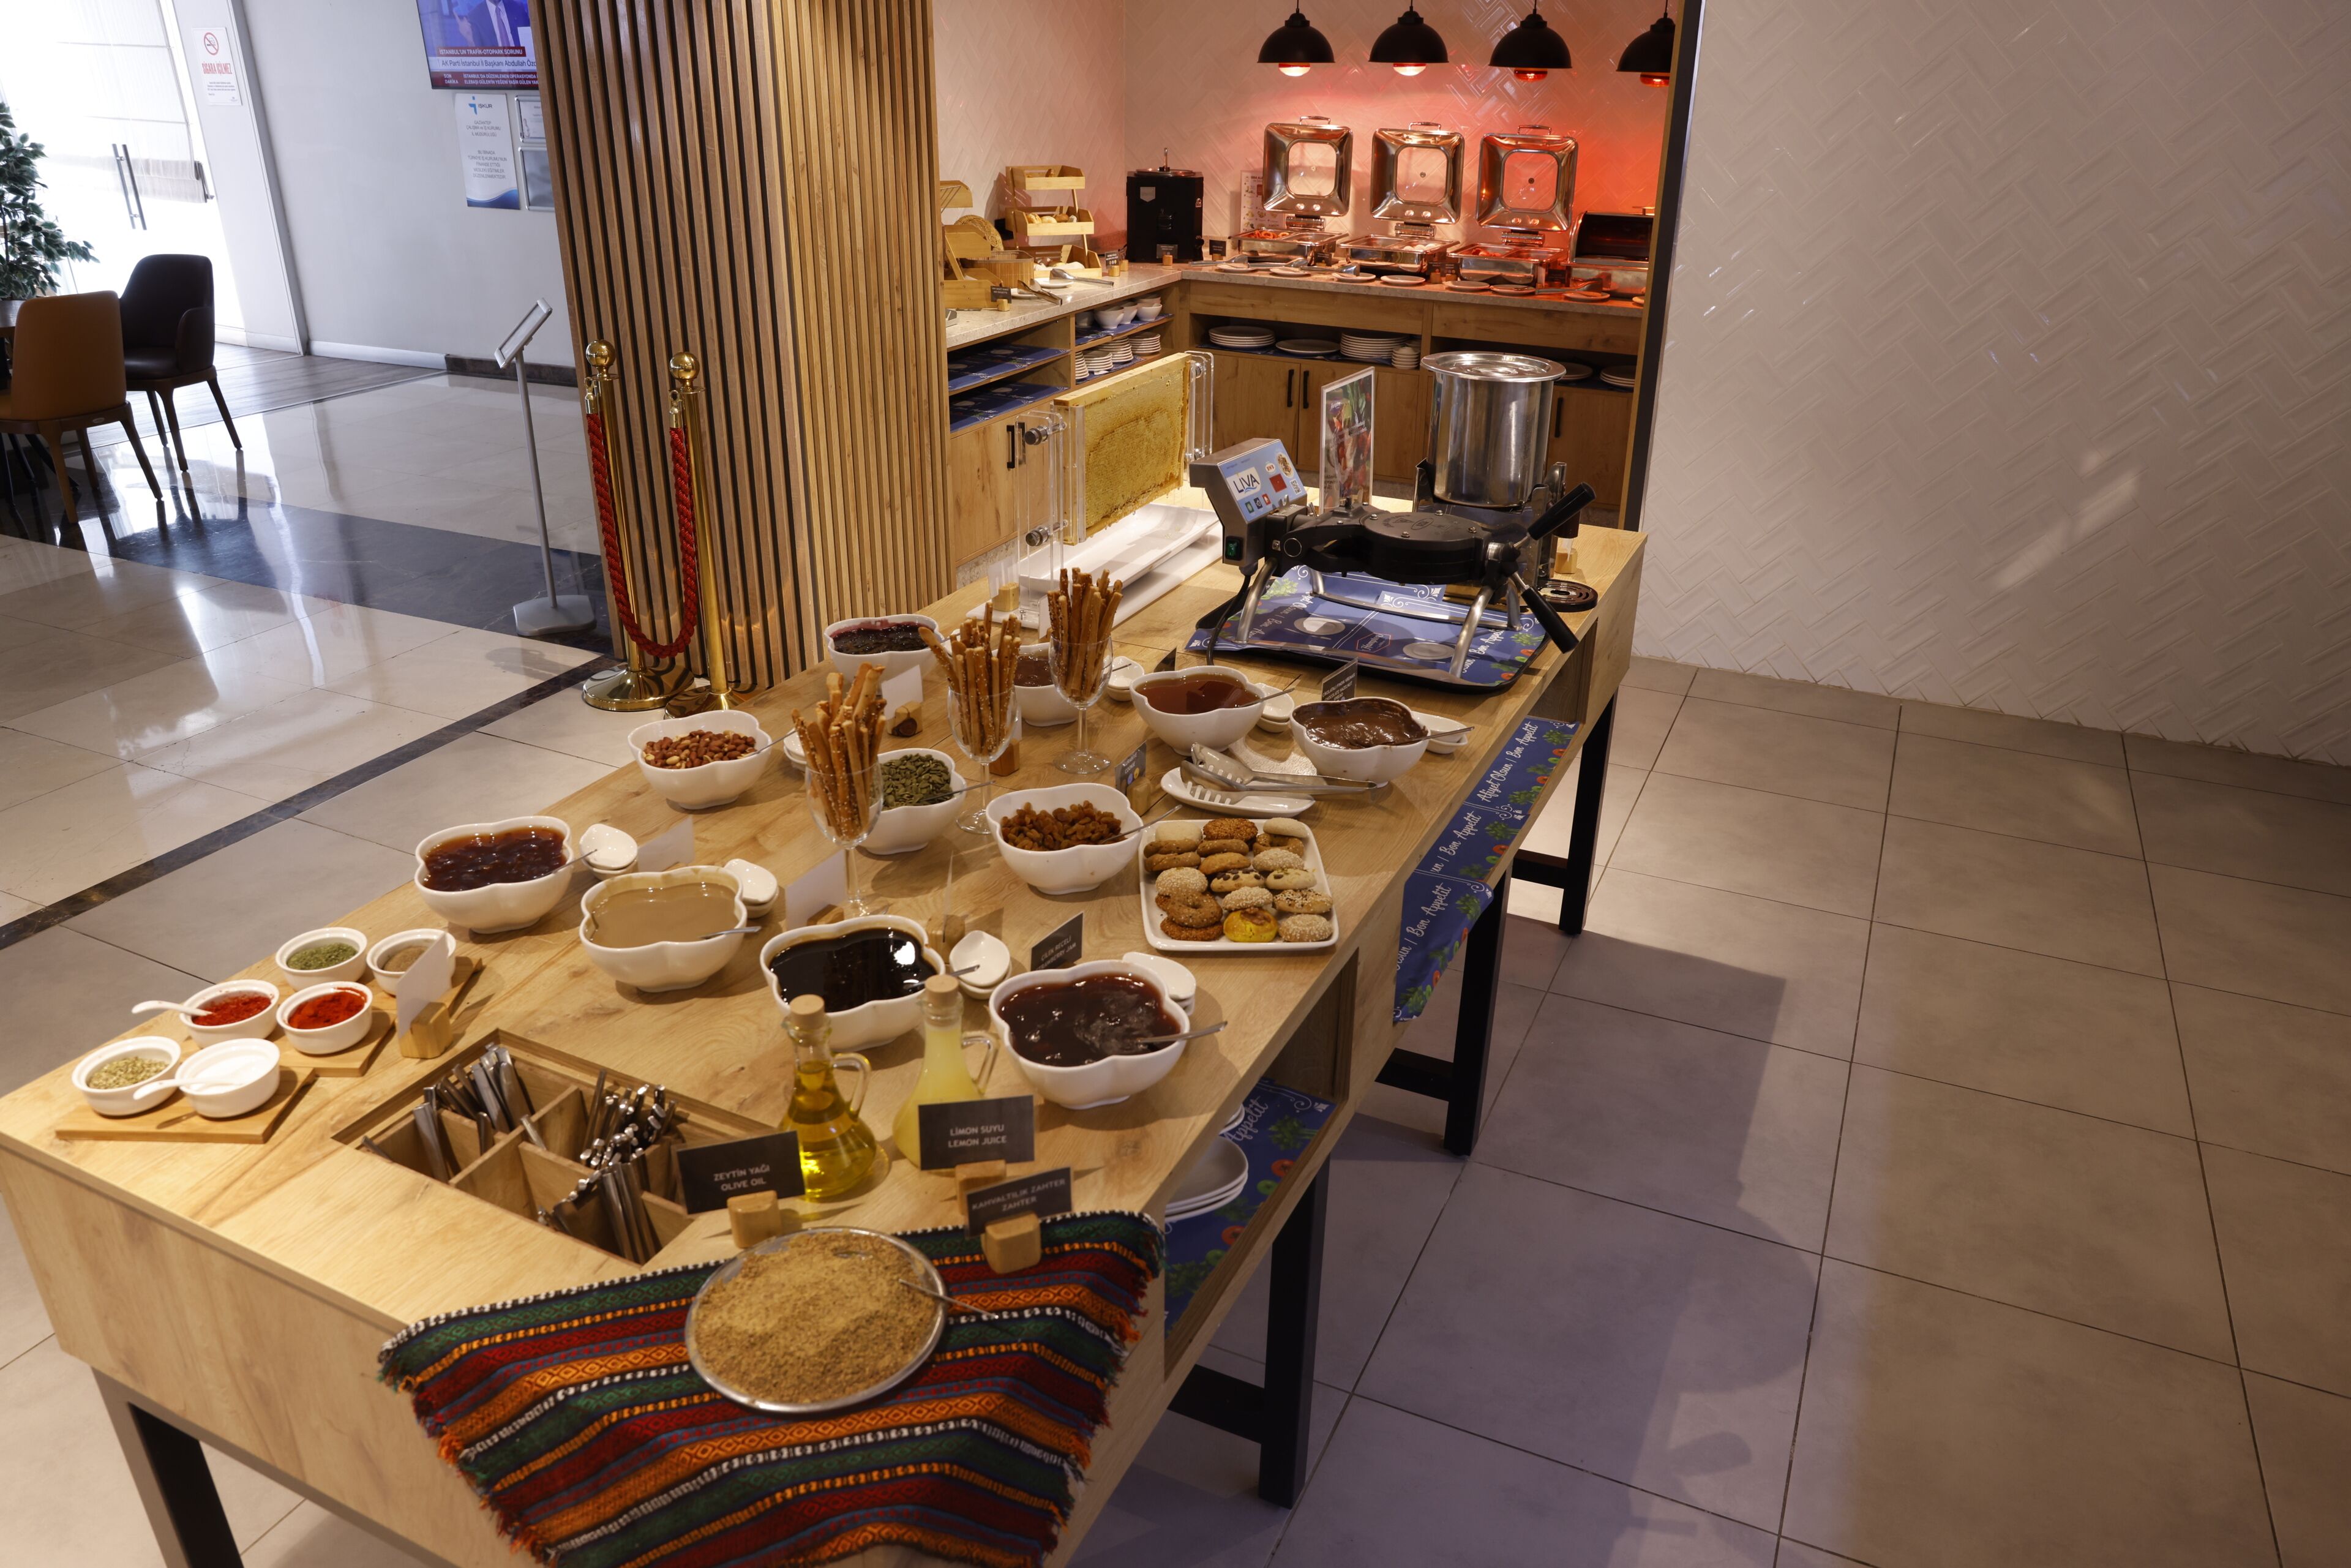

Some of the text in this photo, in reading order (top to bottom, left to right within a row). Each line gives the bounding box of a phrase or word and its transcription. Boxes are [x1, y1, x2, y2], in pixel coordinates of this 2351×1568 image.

[1476, 778, 1502, 803] Afiyet
[1490, 763, 1513, 781] Olsun
[1505, 746, 1524, 759] Bon
[1515, 721, 1539, 746] Appetit
[1439, 841, 1461, 856] Bon
[1453, 811, 1482, 840] Appetit
[1406, 918, 1430, 937] Bon
[1420, 882, 1452, 916] Appetit
[950, 1124, 1005, 1136] LİMON SUYU
[948, 1135, 1007, 1148] LEMON JUICE
[713, 1164, 770, 1182] ZEYTİN YAĞI
[721, 1177, 767, 1191] OLIVE OIL
[1030, 1178, 1066, 1193] ZAHTER
[1002, 1196, 1038, 1212] ZAHTER
